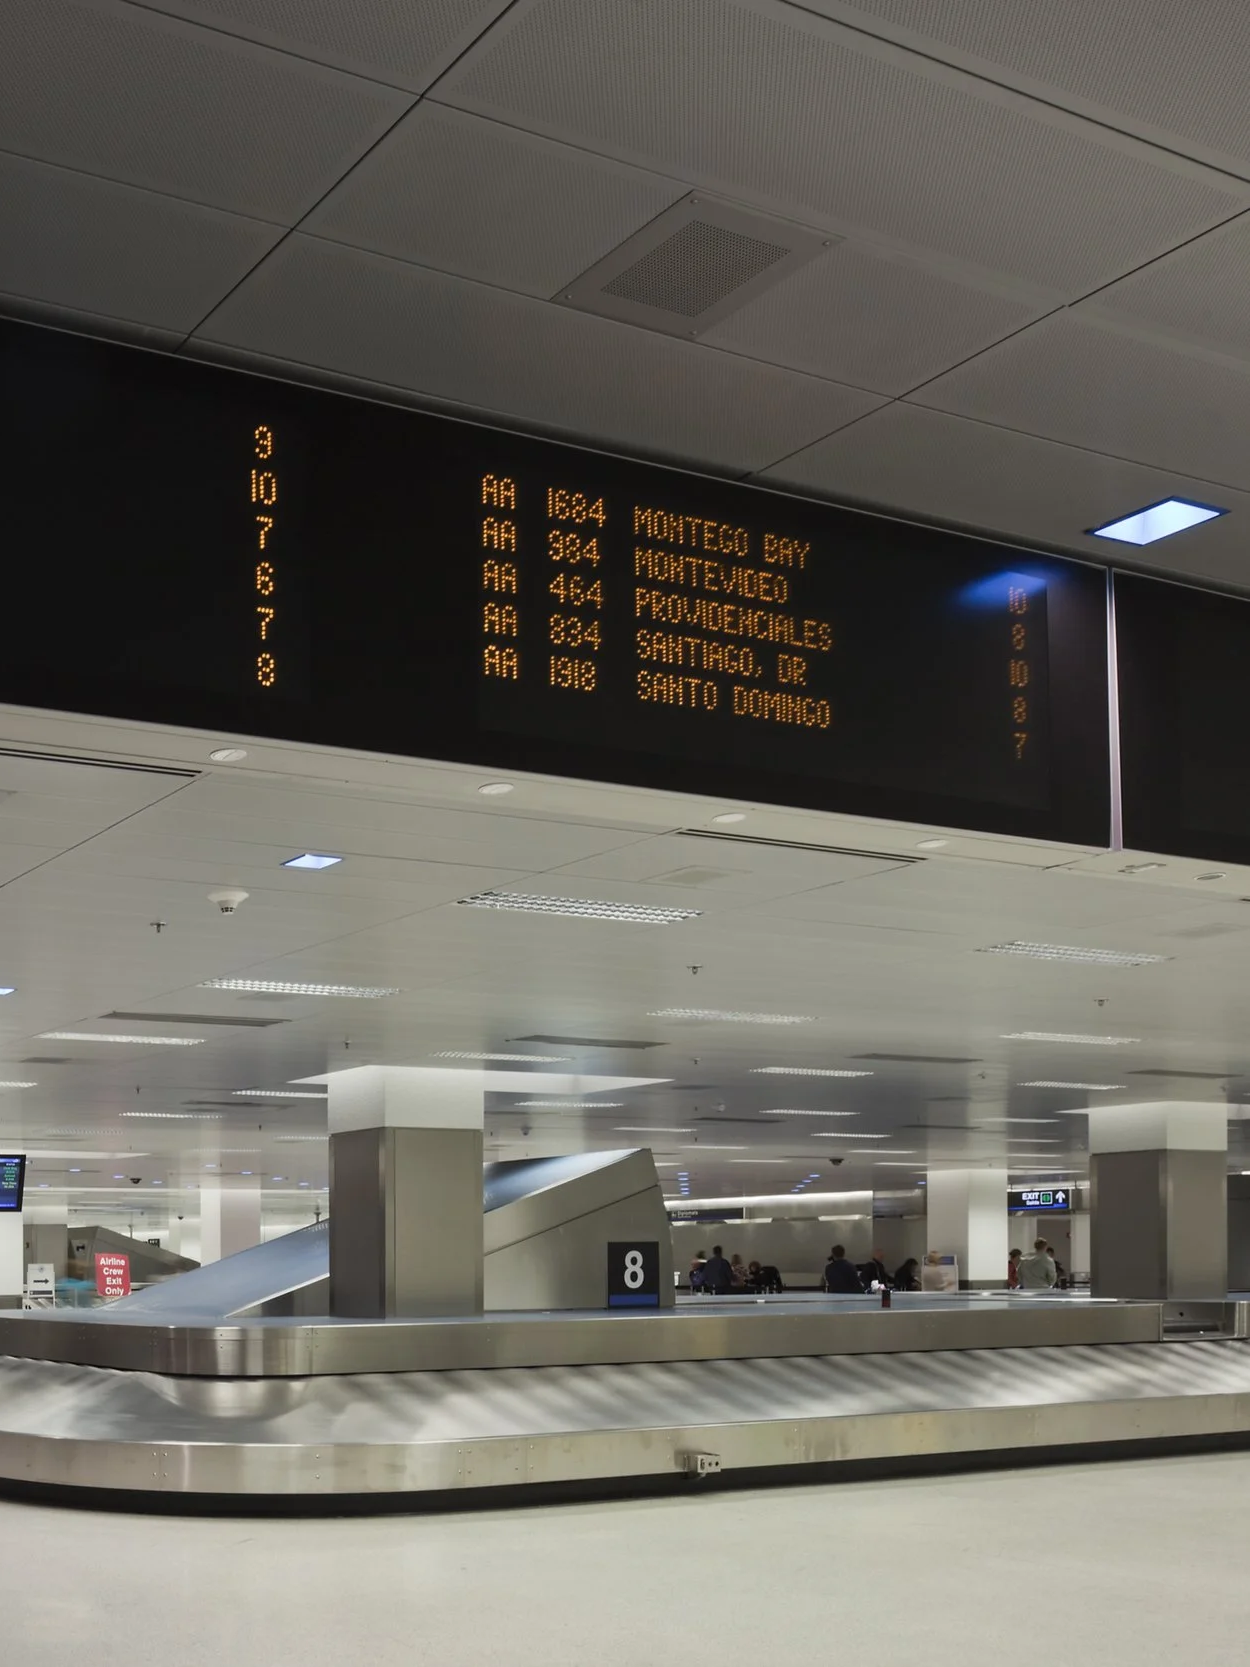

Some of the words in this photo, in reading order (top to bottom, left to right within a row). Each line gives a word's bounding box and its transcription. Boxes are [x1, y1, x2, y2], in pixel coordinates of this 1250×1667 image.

[254, 425, 273, 459] 9
[251, 469, 277, 506] 10
[257, 515, 273, 550] 7
[482, 474, 516, 510] AA
[547, 488, 606, 527] 1684
[634, 507, 748, 556] MONTEGO
[764, 534, 809, 567] BAY
[1009, 586, 1028, 614] 10
[482, 516, 516, 552] AA
[547, 530, 600, 566] 984
[635, 548, 788, 603] MONTEVIDEO
[256, 561, 274, 596] 6
[257, 606, 275, 640] 7
[483, 560, 517, 593] AA
[548, 574, 602, 608] 464
[635, 587, 831, 651] PROVIDENCIALES
[1010, 659, 1028, 687] 10
[483, 602, 518, 636] AA
[548, 614, 601, 650] 834
[637, 629, 761, 676] SANTIAGO,
[778, 654, 807, 684] DR
[257, 652, 275, 686] 8
[483, 645, 519, 680] AA
[550, 656, 596, 692] 1918
[638, 670, 717, 710] SANTO
[734, 686, 830, 728] DOMINGO
[1014, 732, 1027, 759] 7
[1022, 1192, 1039, 1200] EXIT
[100, 1257, 126, 1267] Airline
[103, 1267, 124, 1276] Crew
[624, 1250, 644, 1289] 8
[105, 1286, 125, 1297] Only
[106, 1277, 122, 1286] Exit
